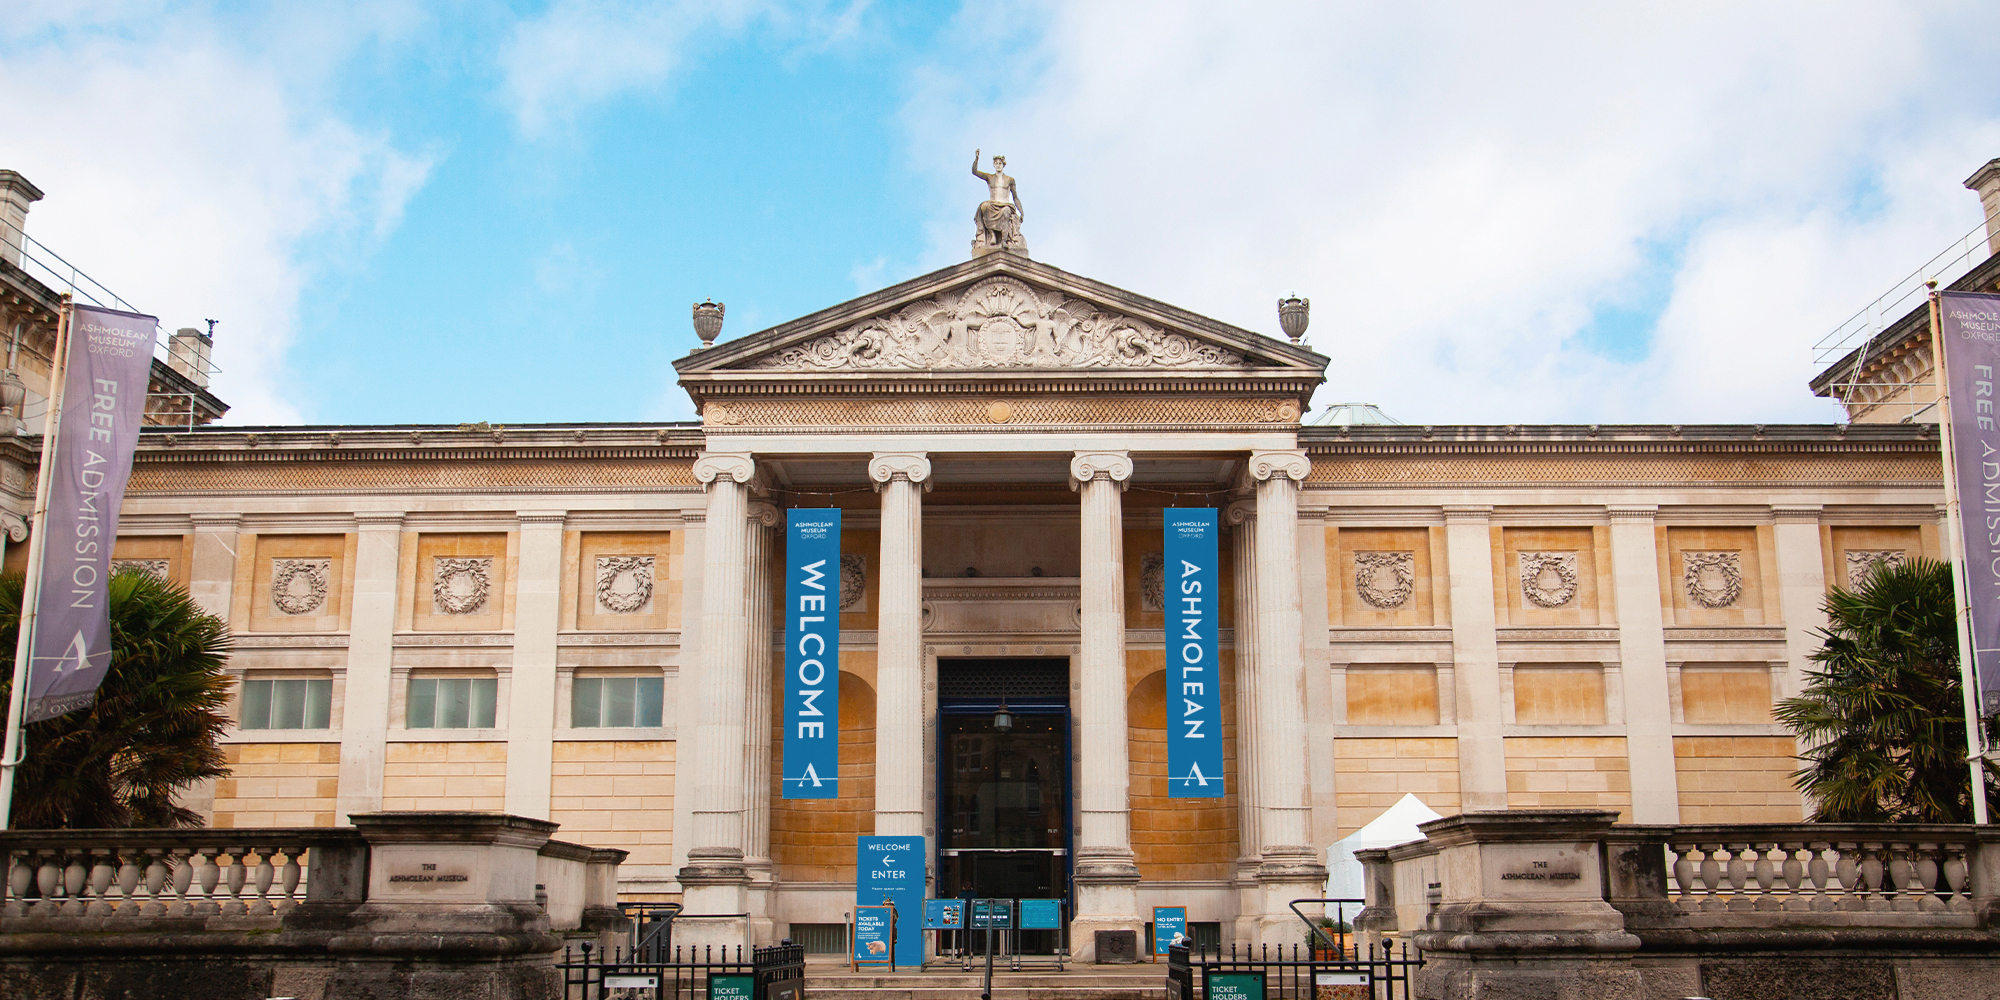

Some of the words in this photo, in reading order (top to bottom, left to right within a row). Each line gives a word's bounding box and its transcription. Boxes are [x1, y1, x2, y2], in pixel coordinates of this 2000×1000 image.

[1949, 310, 2000, 321] ASHMOLE
[79, 322, 149, 342] ASHMOLEAN
[88, 334, 137, 349] MUSEUM
[88, 344, 134, 359] OXFORD
[1974, 363, 1993, 432] FREE
[88, 378, 118, 444] FREE
[70, 449, 108, 609] ADMISSION
[798, 559, 826, 739] WELCOME
[1181, 559, 1205, 739] ASHMOLEAN
[421, 863, 437, 871] THE
[871, 870, 906, 879] ENTER
[1549, 872, 1580, 880] MUSEUM
